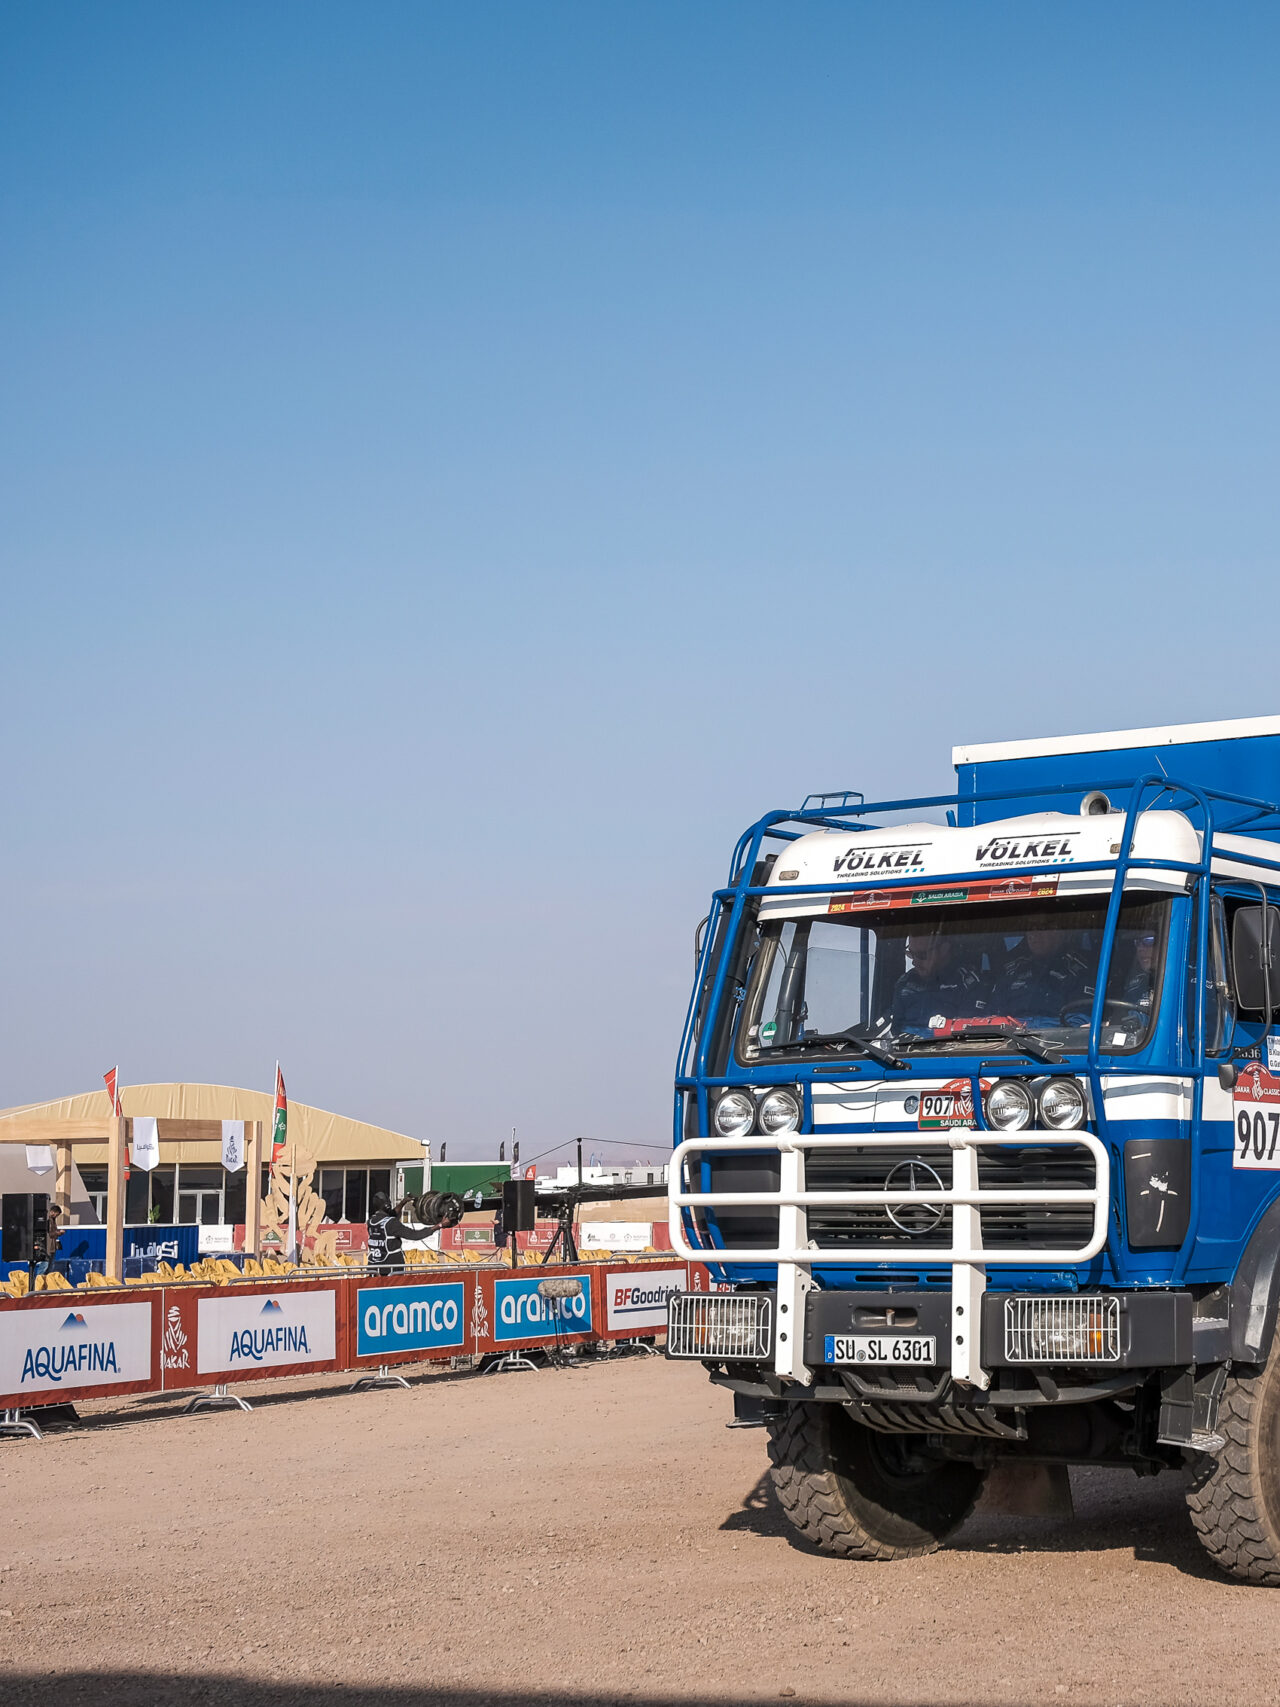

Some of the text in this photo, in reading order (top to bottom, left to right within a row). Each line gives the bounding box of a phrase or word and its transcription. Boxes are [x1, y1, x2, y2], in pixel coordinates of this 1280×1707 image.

[833, 843, 932, 872] VÖLKEL
[975, 832, 1081, 861] VÖLKEL
[1234, 1086, 1280, 1096] DAKAR CLASSIC
[924, 1096, 953, 1116] 907
[1238, 1110, 1280, 1160] 907
[364, 1299, 458, 1338] aramco
[470, 1321, 490, 1338] DAKAR
[229, 1325, 309, 1362] AQUAFINA
[836, 1340, 932, 1361] SU SL 6301
[21, 1341, 118, 1384] AQUAFINA
[160, 1349, 190, 1370] DAKAR
